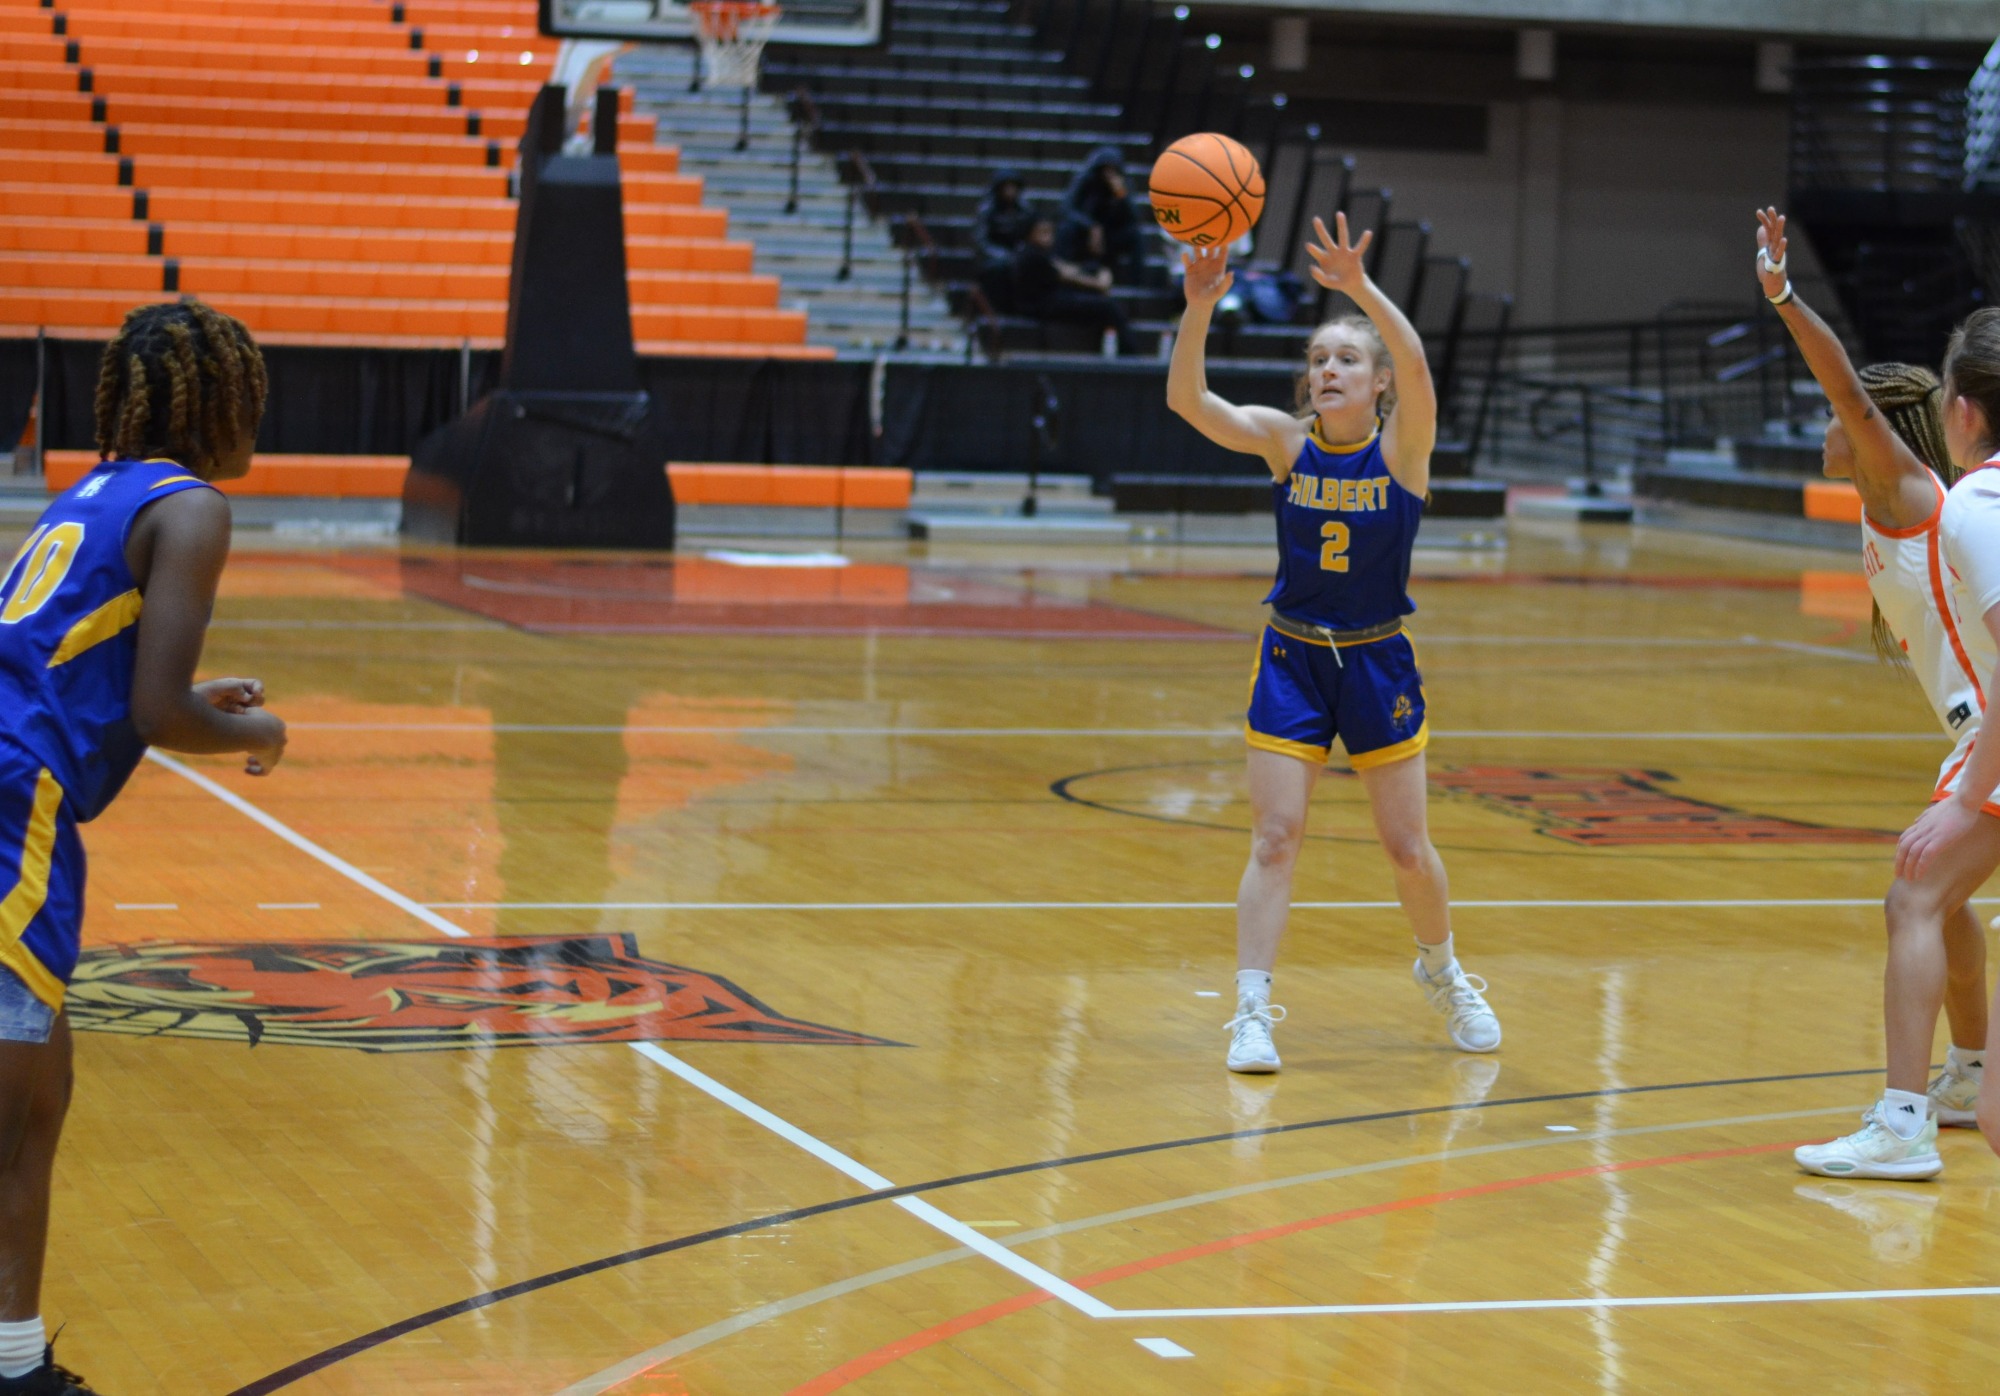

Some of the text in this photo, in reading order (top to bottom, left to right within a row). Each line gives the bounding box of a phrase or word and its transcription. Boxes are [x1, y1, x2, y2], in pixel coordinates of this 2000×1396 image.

[1287, 472, 1390, 512] HILBERT
[0, 521, 85, 625] 0
[1320, 520, 1350, 573] 2
